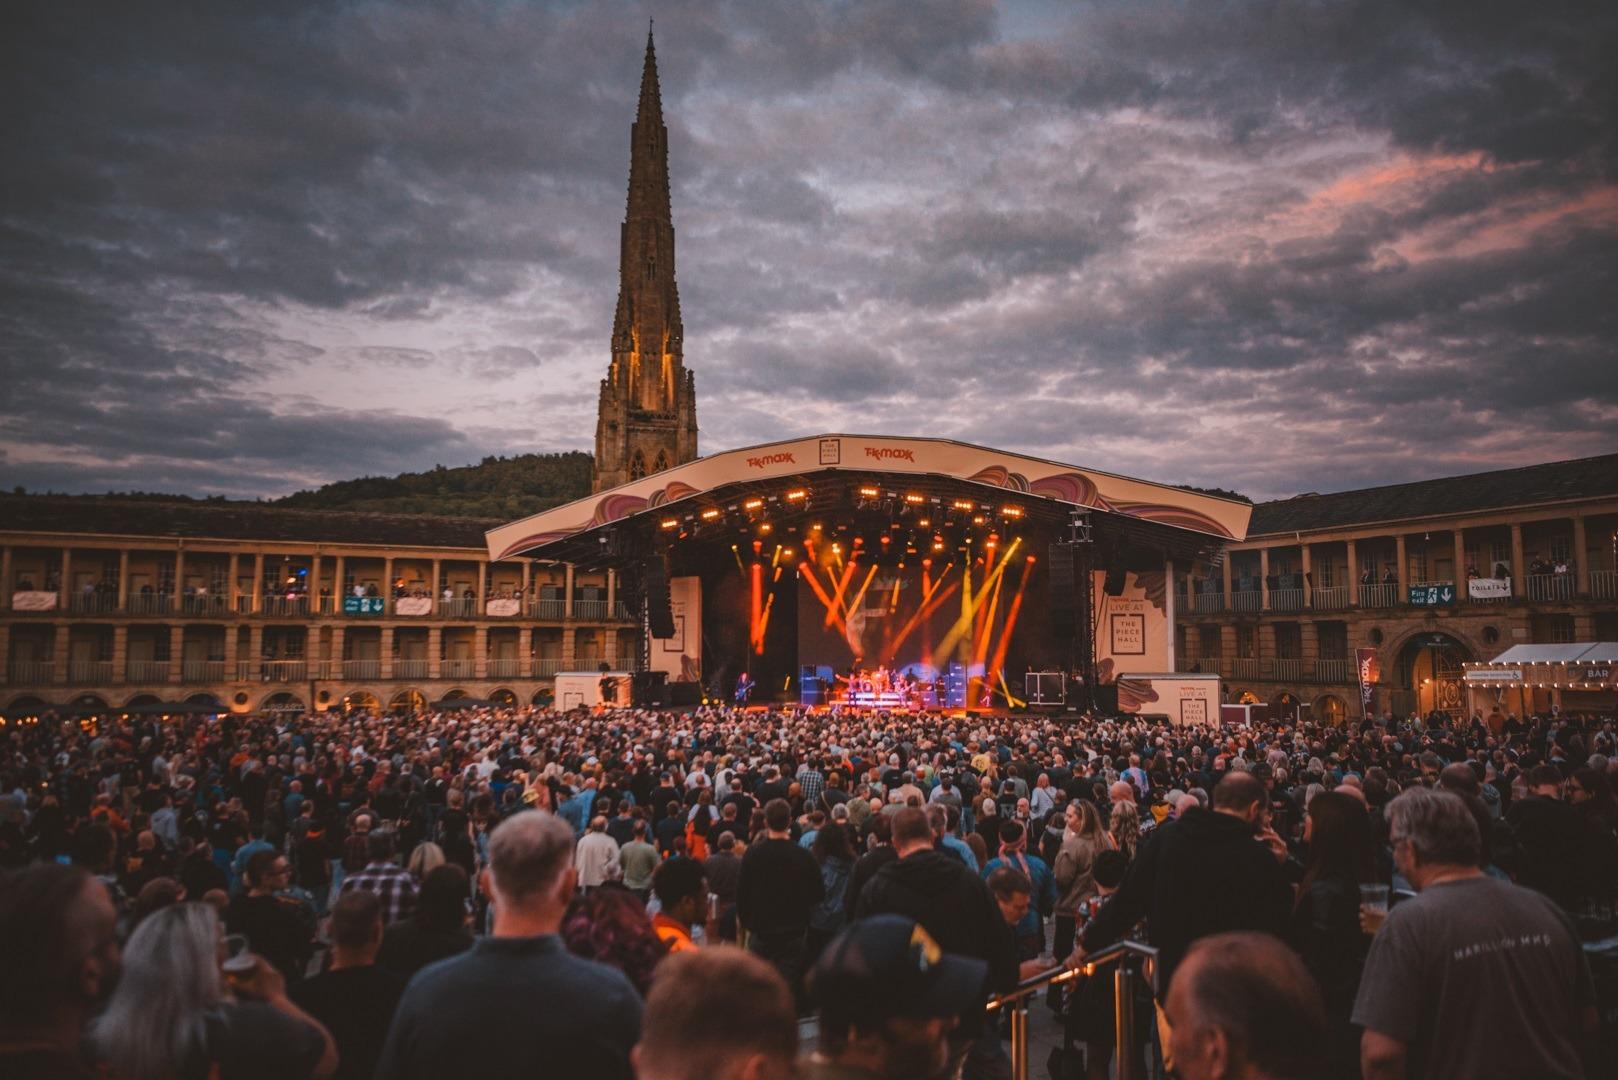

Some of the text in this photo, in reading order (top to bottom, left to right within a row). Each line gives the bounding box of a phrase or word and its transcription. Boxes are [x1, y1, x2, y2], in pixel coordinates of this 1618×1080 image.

[1110, 603, 1144, 611] LIVE AT
[1587, 669, 1609, 678] BAR
